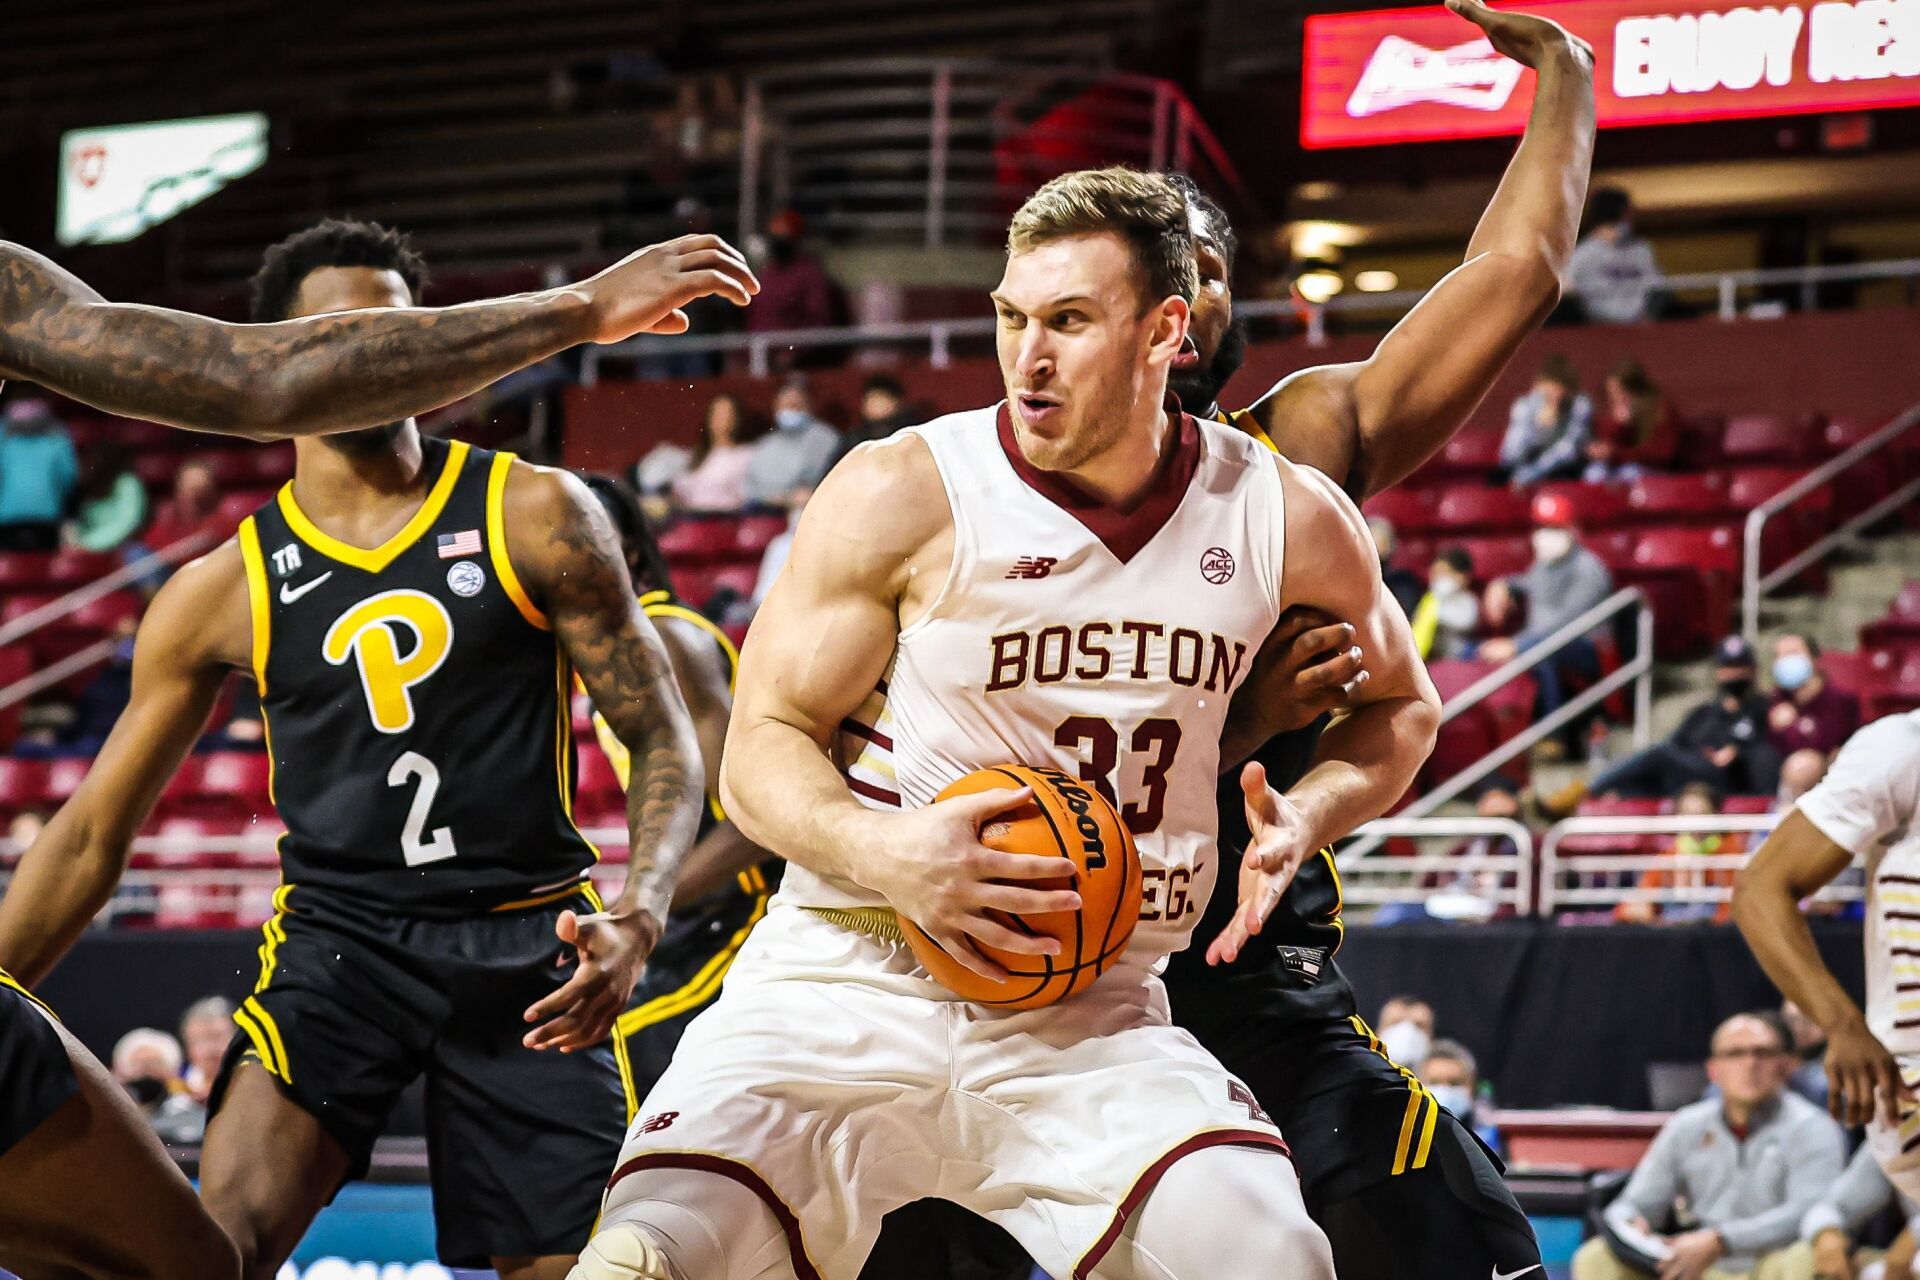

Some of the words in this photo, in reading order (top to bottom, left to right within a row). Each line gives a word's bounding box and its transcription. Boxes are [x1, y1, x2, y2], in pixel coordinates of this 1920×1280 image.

[1613, 5, 1804, 97] ENJOY
[322, 588, 454, 733] P
[985, 620, 1248, 695] BOSTON
[387, 751, 457, 867] 2
[1053, 714, 1183, 835] 33
